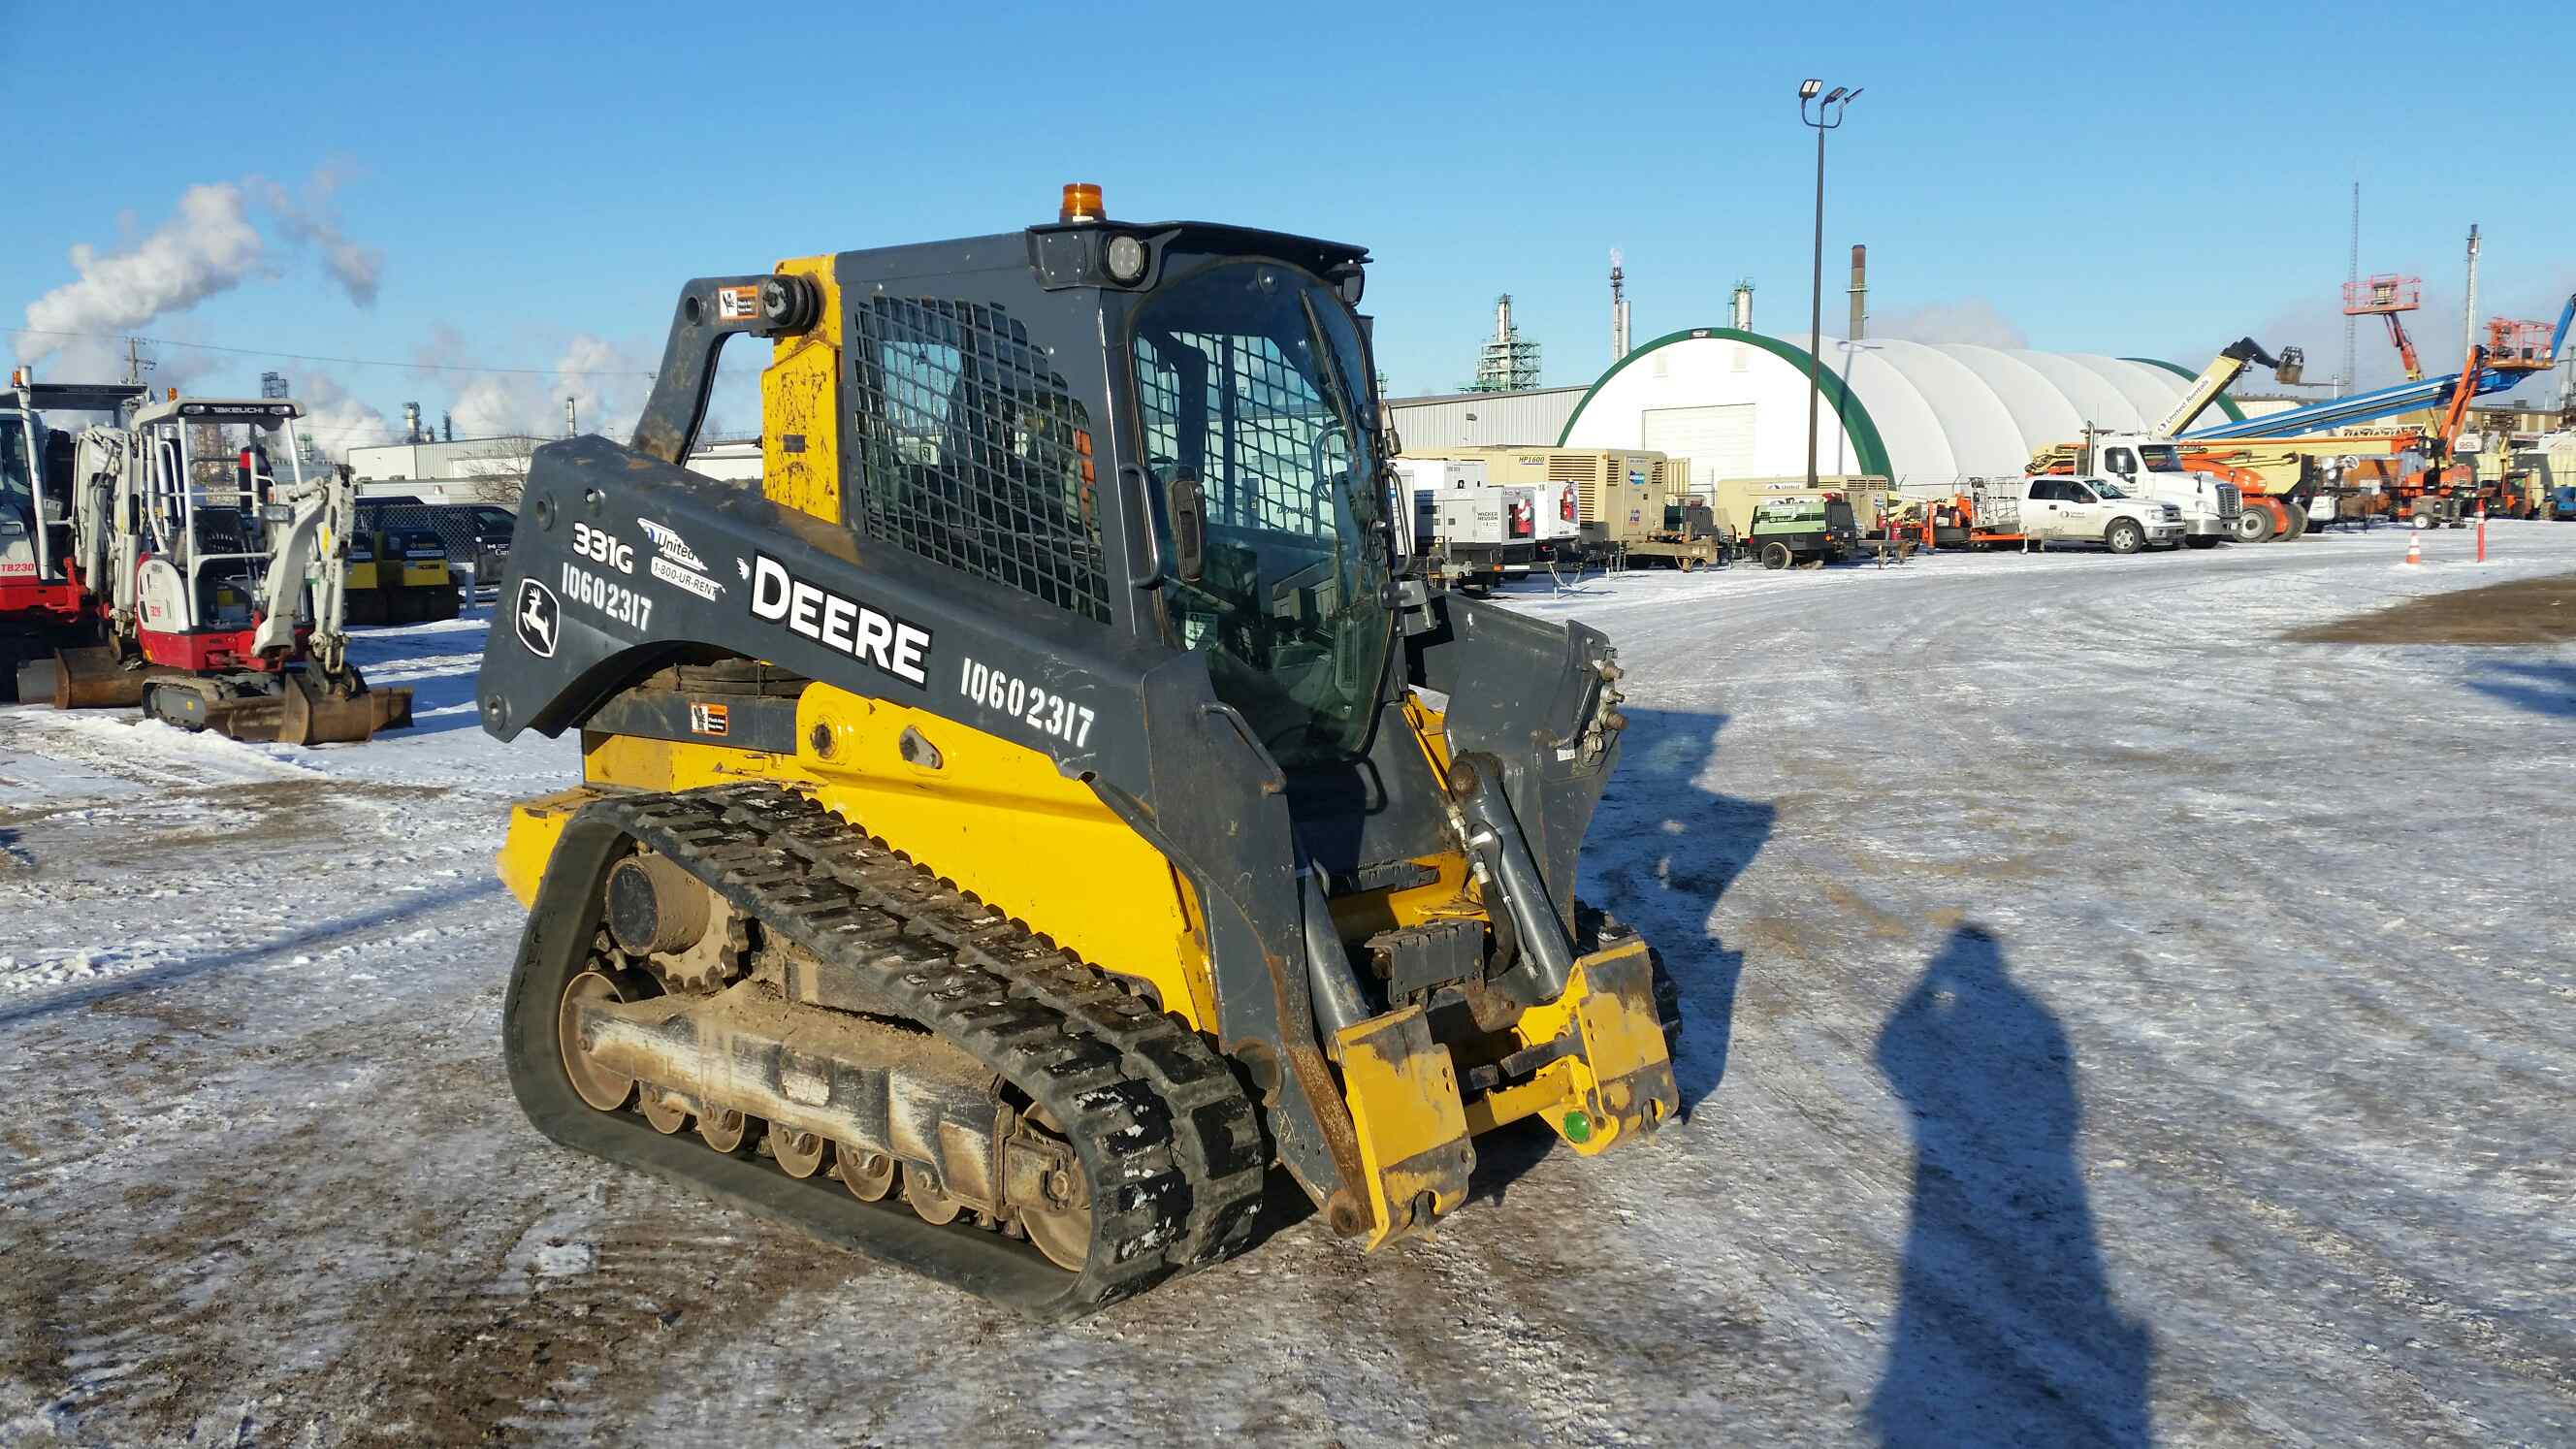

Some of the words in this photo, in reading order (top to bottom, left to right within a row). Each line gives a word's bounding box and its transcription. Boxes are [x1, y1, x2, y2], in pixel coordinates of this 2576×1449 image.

[2, 563, 35, 572] TB230
[572, 521, 635, 574] 331G
[562, 562, 653, 631] 10602317
[752, 554, 931, 684] DEERE
[960, 657, 1095, 748] 10602317
